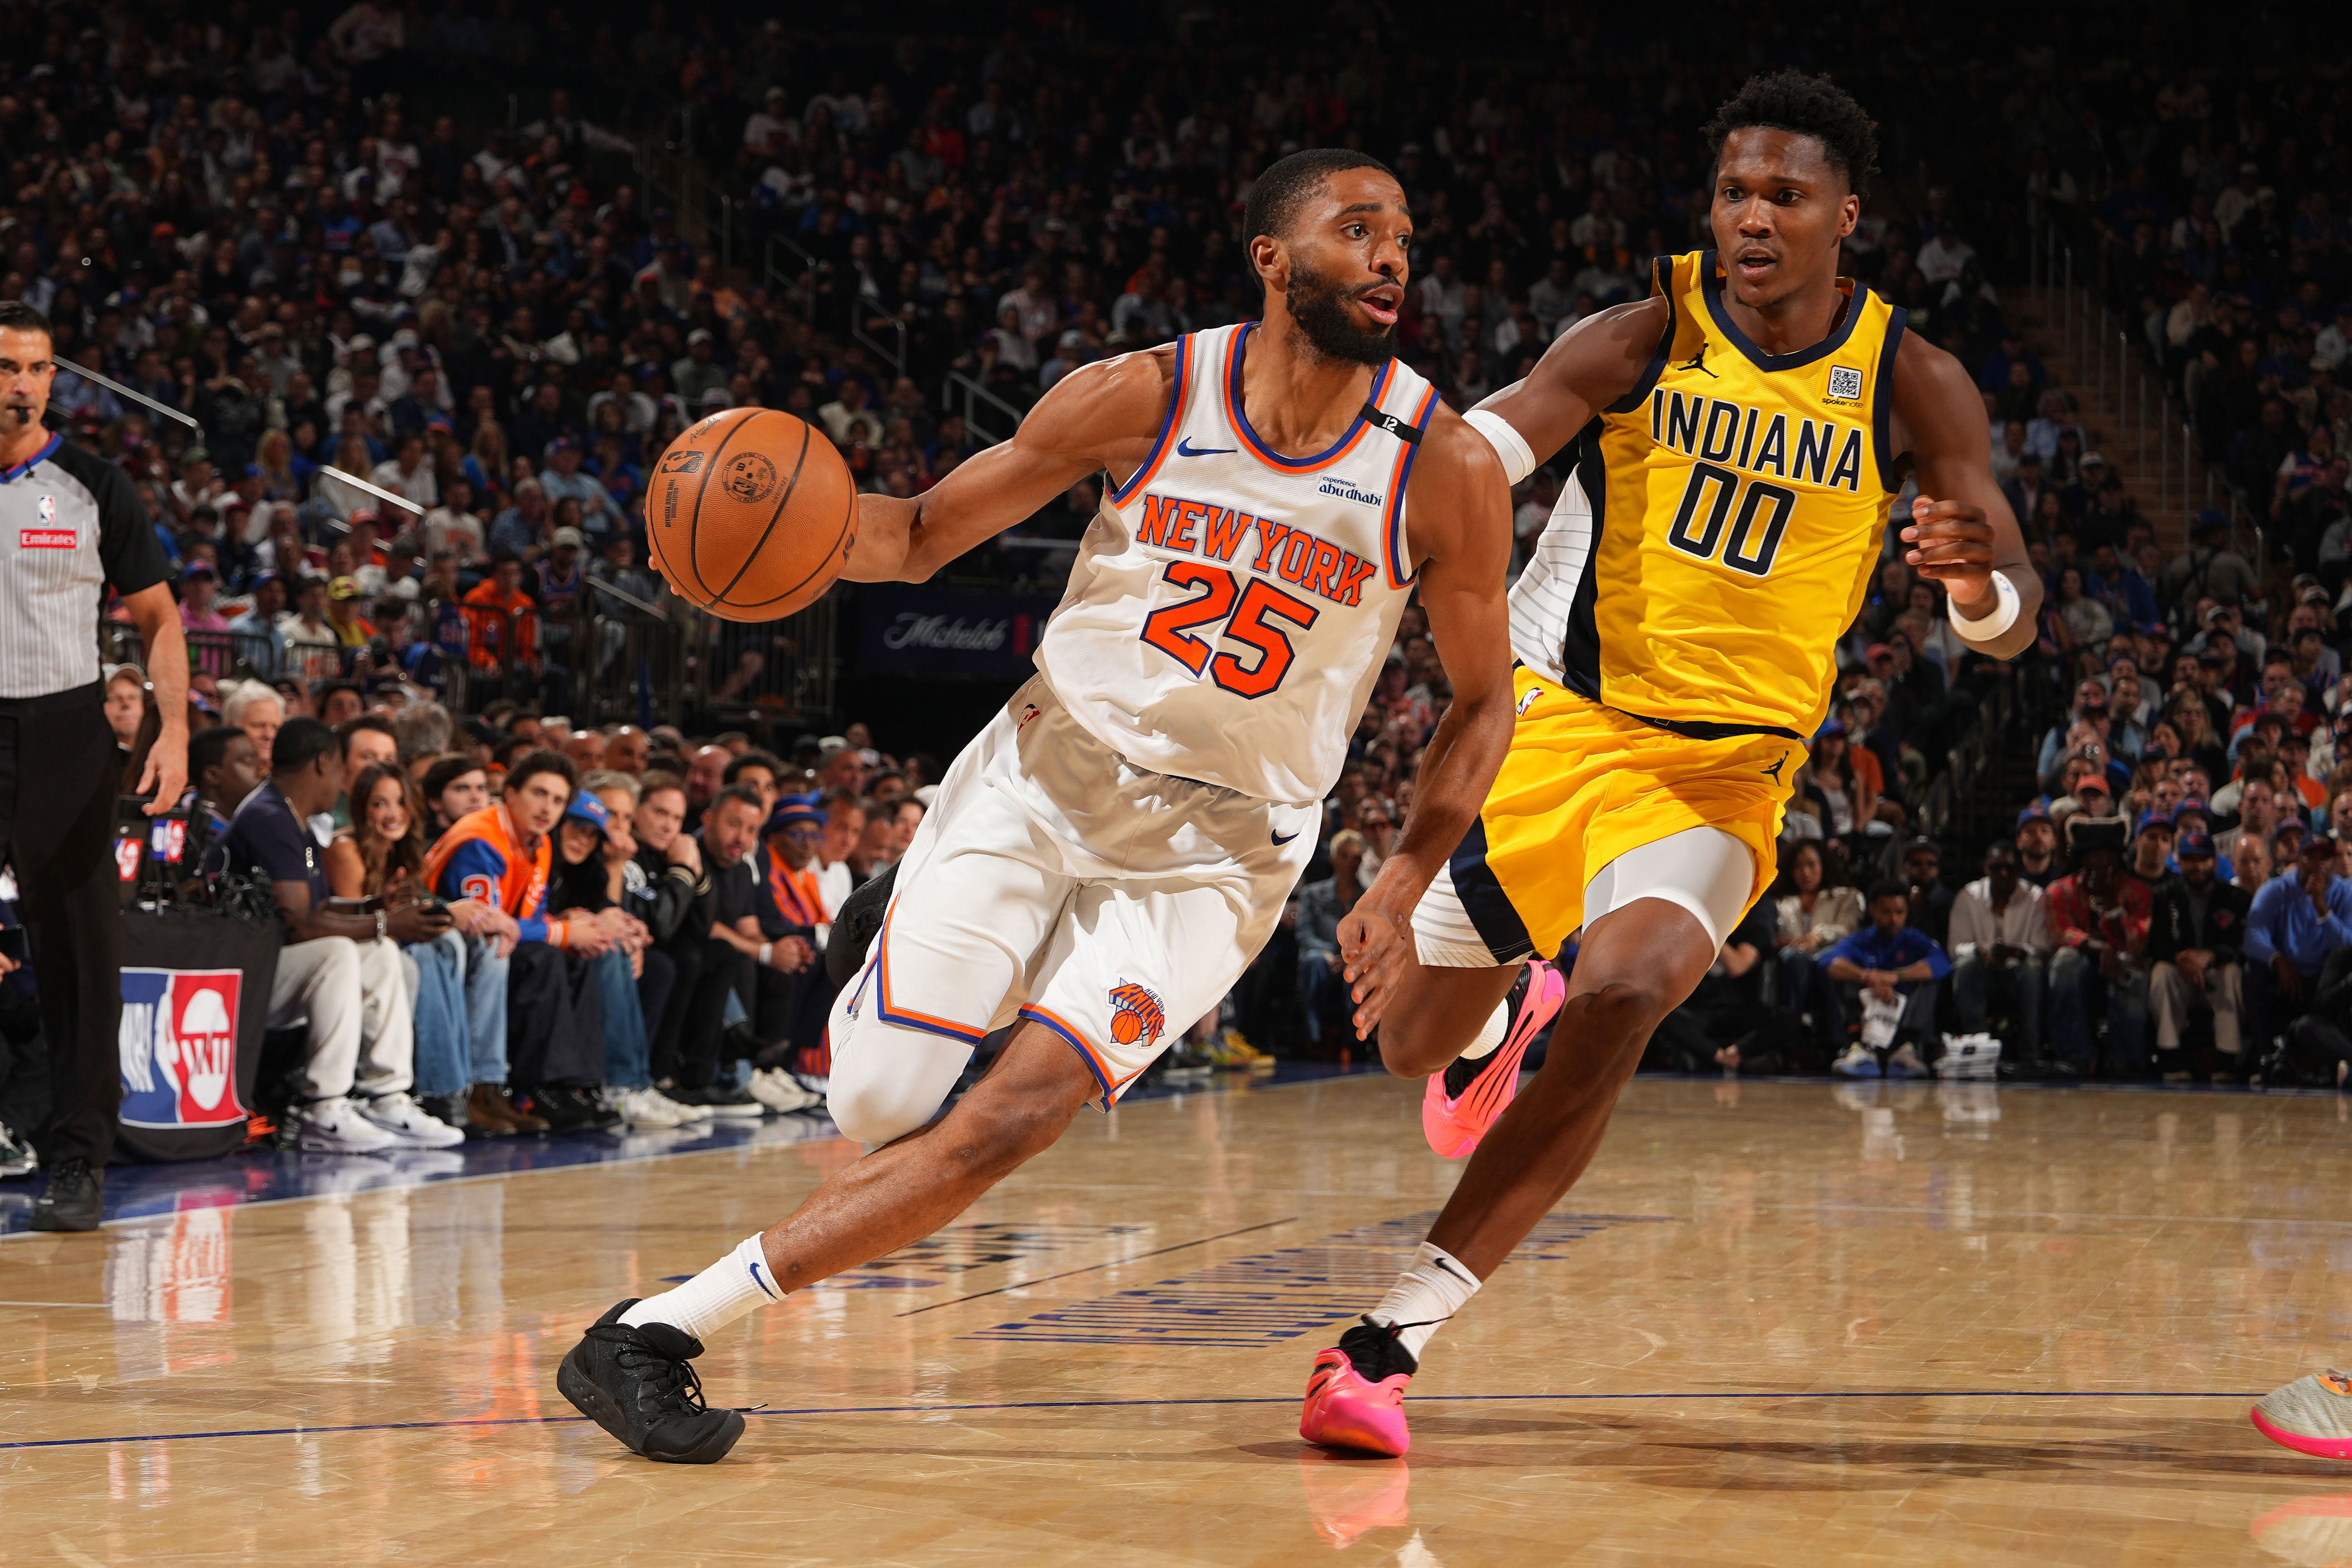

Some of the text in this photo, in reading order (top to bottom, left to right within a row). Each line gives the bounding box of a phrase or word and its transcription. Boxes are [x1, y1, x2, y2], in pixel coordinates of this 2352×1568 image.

[1822, 398, 1863, 408] spokenote
[1382, 416, 1398, 432] 12
[1651, 386, 1863, 493] INDIANA
[1319, 484, 1382, 506] abu dhabi
[1323, 476, 1356, 488] experience
[1666, 460, 1798, 578] 00
[21, 531, 76, 546] Emirates
[1135, 493, 1380, 608] NEW YORK
[1139, 560, 1320, 700] 25
[1144, 988, 1165, 1014] NEW YORK
[1108, 983, 1165, 1047] KNICKS
